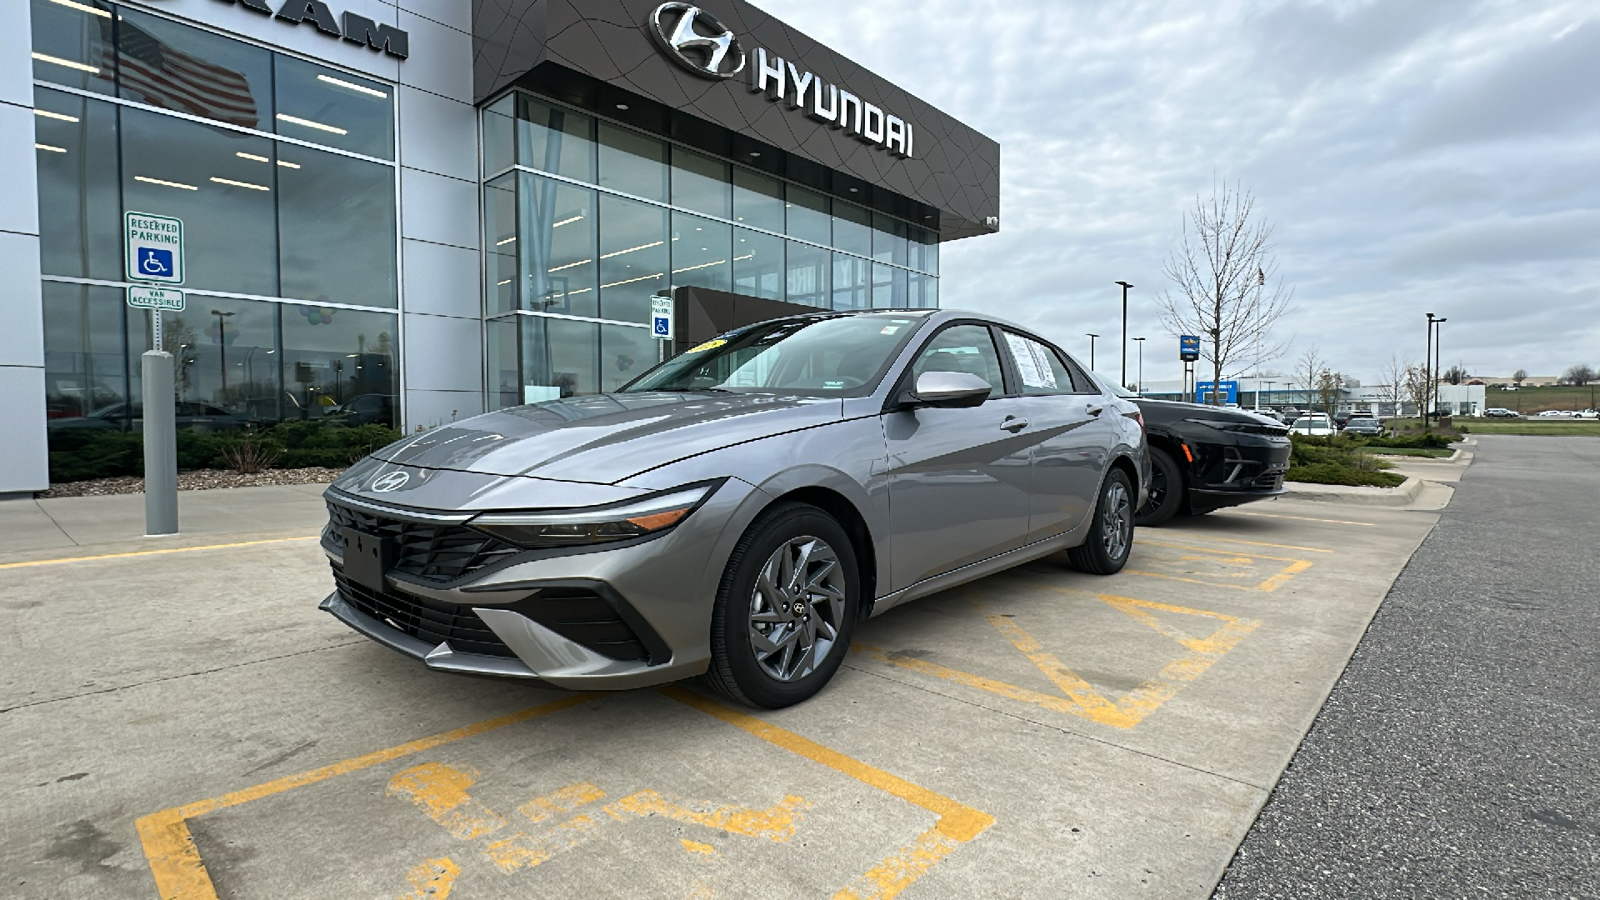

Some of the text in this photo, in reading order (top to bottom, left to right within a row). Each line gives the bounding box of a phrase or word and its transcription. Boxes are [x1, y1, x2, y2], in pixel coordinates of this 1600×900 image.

[749, 47, 914, 159] HYUNDAI
[131, 218, 178, 233] RESERVED
[131, 230, 178, 244] PARKING
[149, 290, 165, 298] VAN
[132, 297, 181, 308] ACCESSIBLE
